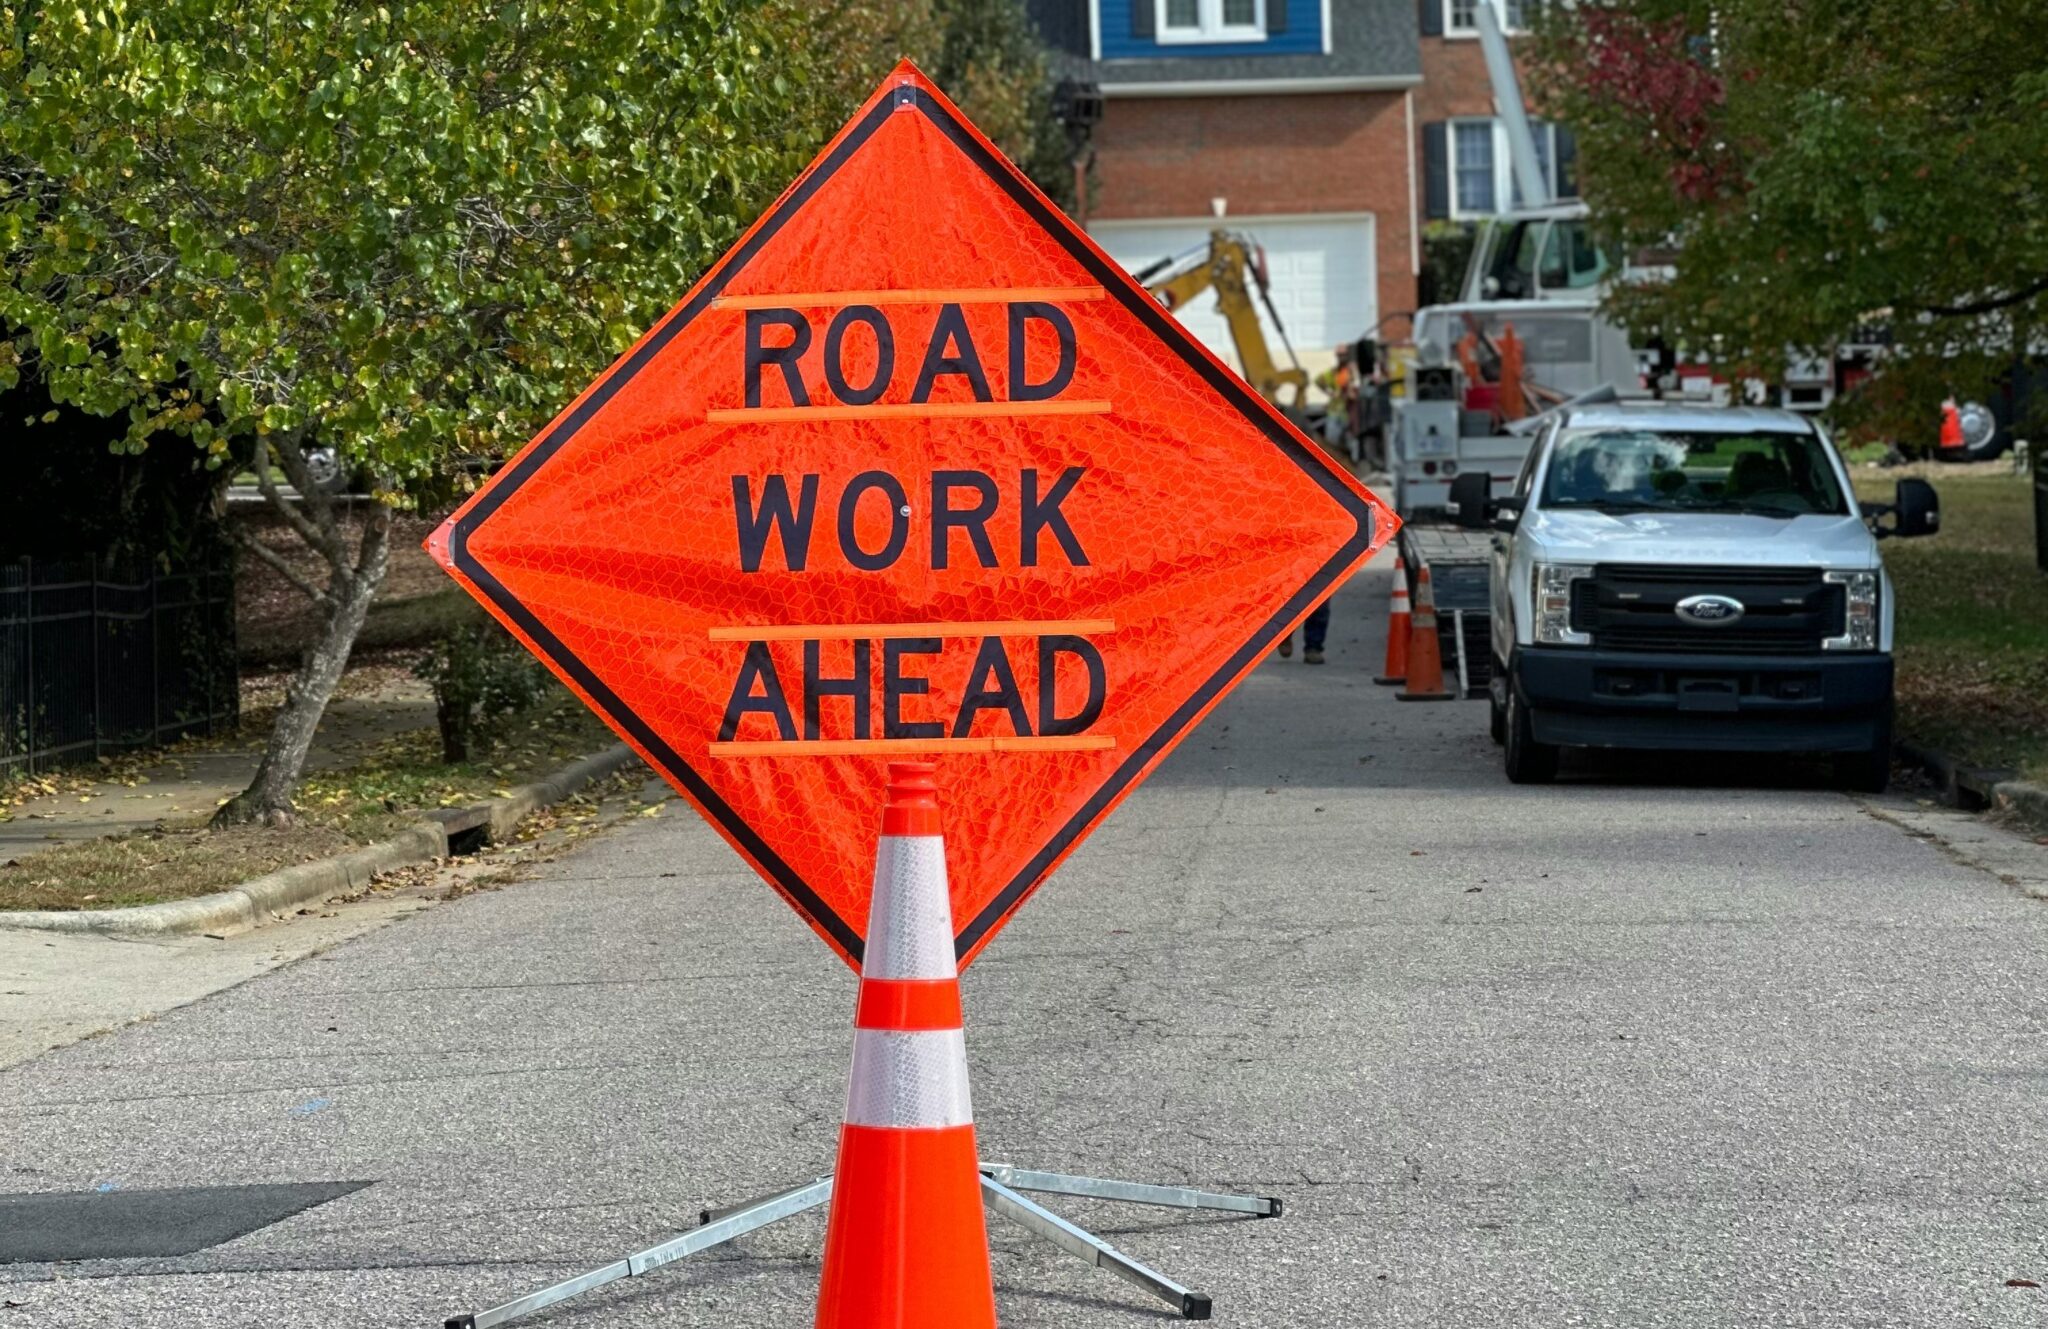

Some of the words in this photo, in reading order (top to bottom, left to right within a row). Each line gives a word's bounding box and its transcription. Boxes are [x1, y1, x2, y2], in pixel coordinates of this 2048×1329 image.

[744, 302, 1077, 407] ROAD
[732, 466, 1089, 573] WORK
[717, 635, 1106, 742] AHEAD
